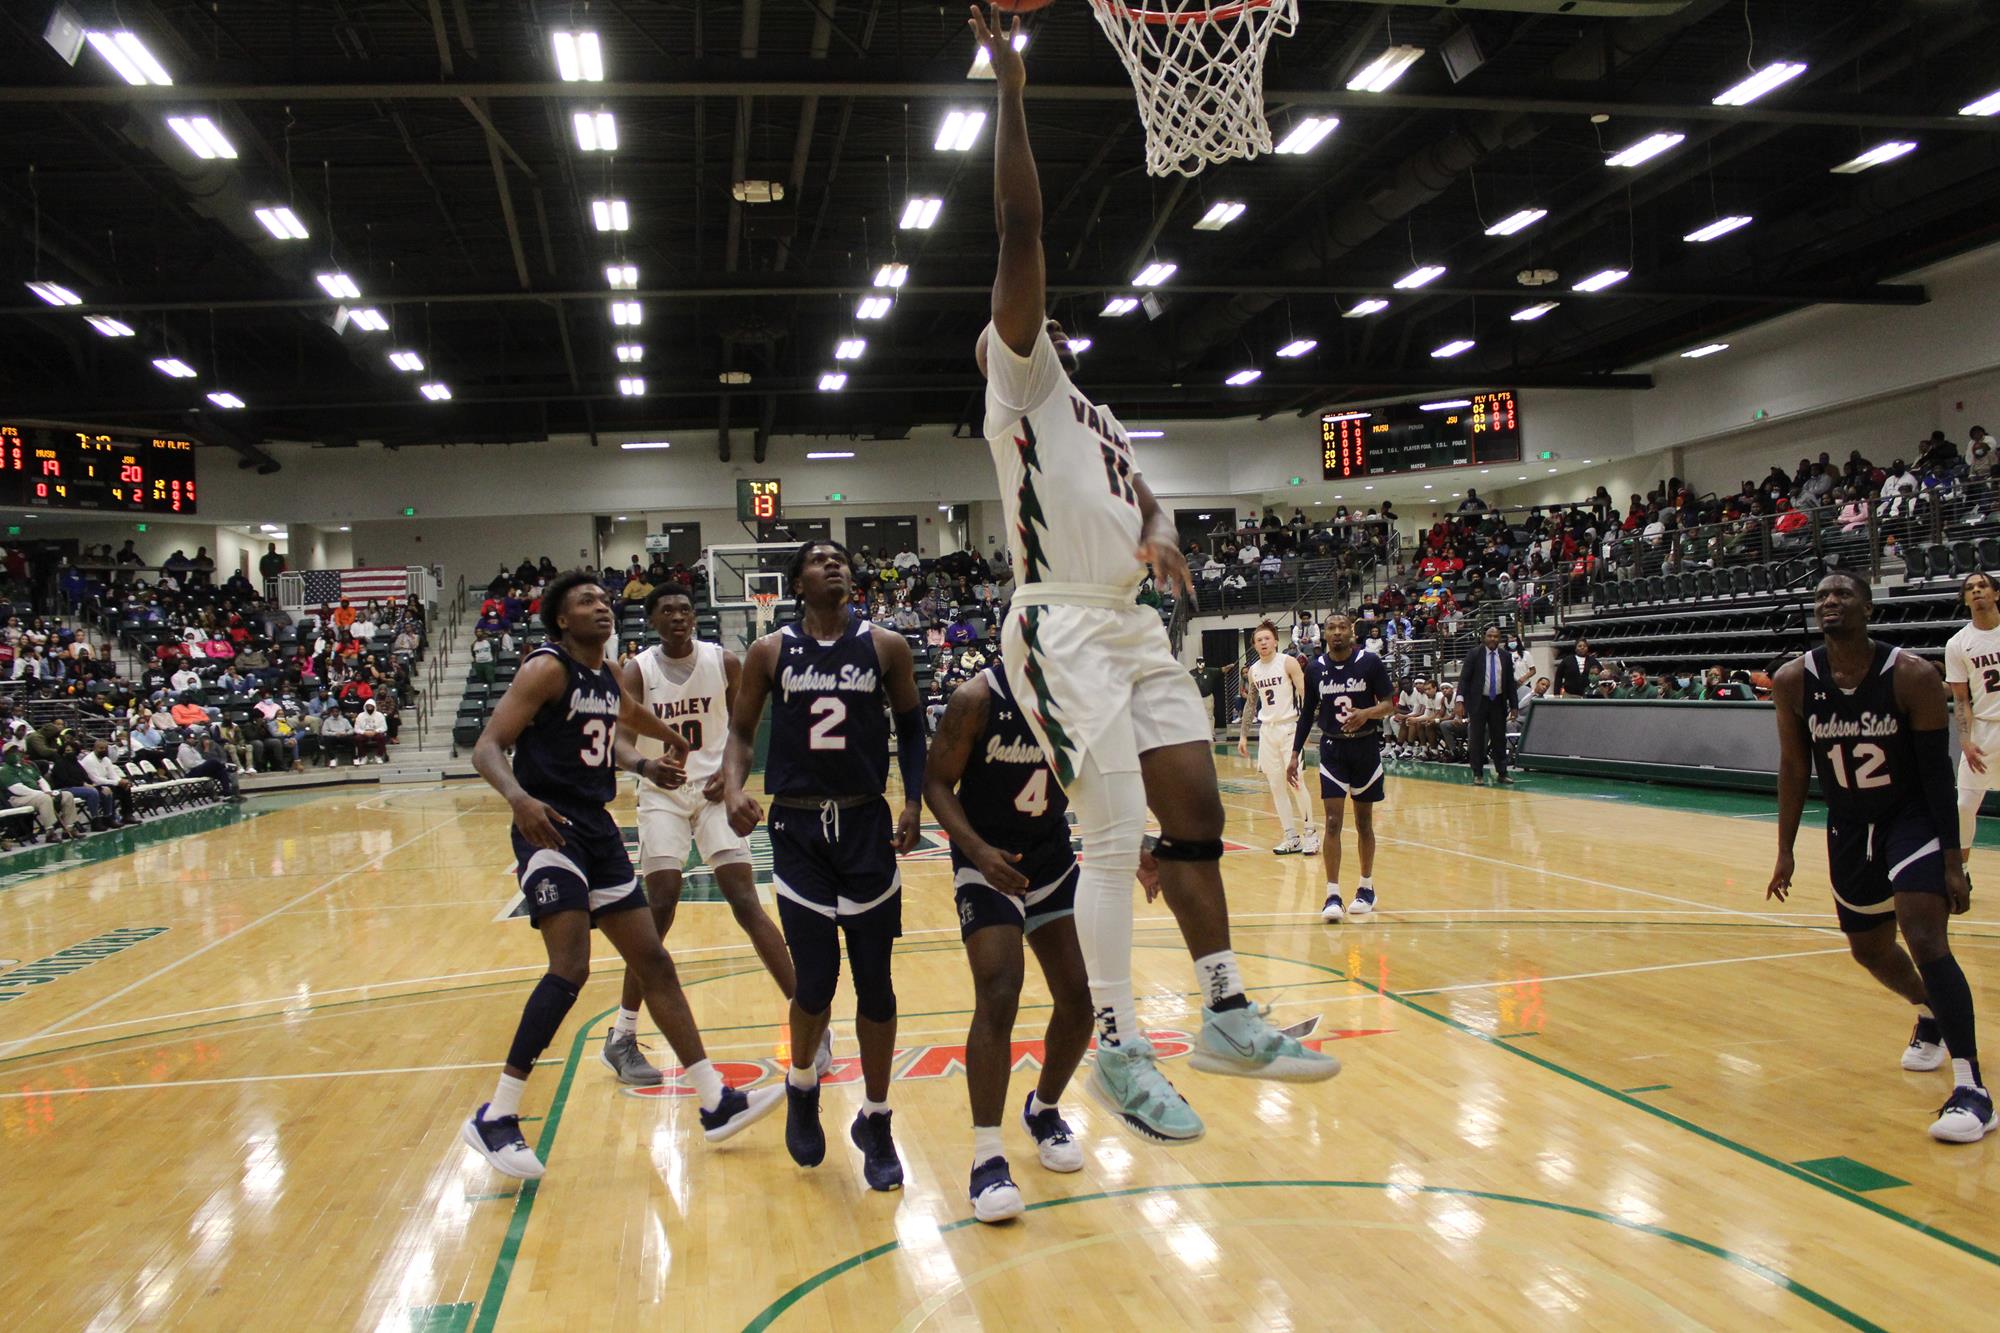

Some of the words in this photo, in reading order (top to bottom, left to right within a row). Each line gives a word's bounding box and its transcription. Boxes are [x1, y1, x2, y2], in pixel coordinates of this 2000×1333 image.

[1498, 392, 1511, 401] PTS
[1472, 403, 1485, 414] 02
[1493, 402, 1500, 411] 0
[1506, 400, 1514, 409] 0
[1446, 415, 1458, 425] JSU
[1473, 413, 1486, 423] 03
[1493, 411, 1500, 421] 0
[1507, 410, 1514, 419] 2
[1323, 423, 1335, 431] 01
[1341, 421, 1348, 429] 0
[1473, 423, 1486, 433] 04
[1493, 421, 1500, 430] 0
[1508, 420, 1515, 429] 0
[1323, 431, 1335, 441] 02
[1341, 430, 1348, 439] 0
[1354, 428, 1361, 437] 0
[12, 437, 21, 447] 4
[1342, 439, 1349, 448] 0
[12, 448, 21, 459] 0
[1325, 449, 1336, 459] 20
[1343, 448, 1350, 457] 0
[43, 460, 60, 476] 19
[1325, 459, 1337, 469] 22
[1343, 457, 1350, 467] 0
[88, 465, 94, 477] 1
[121, 465, 142, 482] 20
[1344, 466, 1351, 476] 0
[36, 483, 47, 497] 0
[55, 485, 66, 497] 4
[171, 480, 180, 490] 0
[112, 488, 122, 500] 4
[132, 488, 143, 503] 2
[171, 490, 180, 501] 0
[755, 495, 773, 517] 13
[781, 664, 837, 704] Jackson
[838, 664, 877, 693] State
[1256, 676, 1283, 690] VALLEY
[1319, 679, 1346, 700] Jackson
[1346, 677, 1366, 693] State
[566, 687, 607, 721] Jackson
[1265, 688, 1276, 706] 2
[652, 696, 712, 720] VALLEY
[1333, 695, 1353, 724] 3
[808, 696, 847, 750] 2
[1808, 711, 1860, 743] Jackson
[1860, 710, 1898, 737] State
[664, 719, 703, 754] 0
[985, 734, 1045, 765] Jackson
[1826, 742, 1892, 790] 12
[1014, 768, 1049, 818] 4
